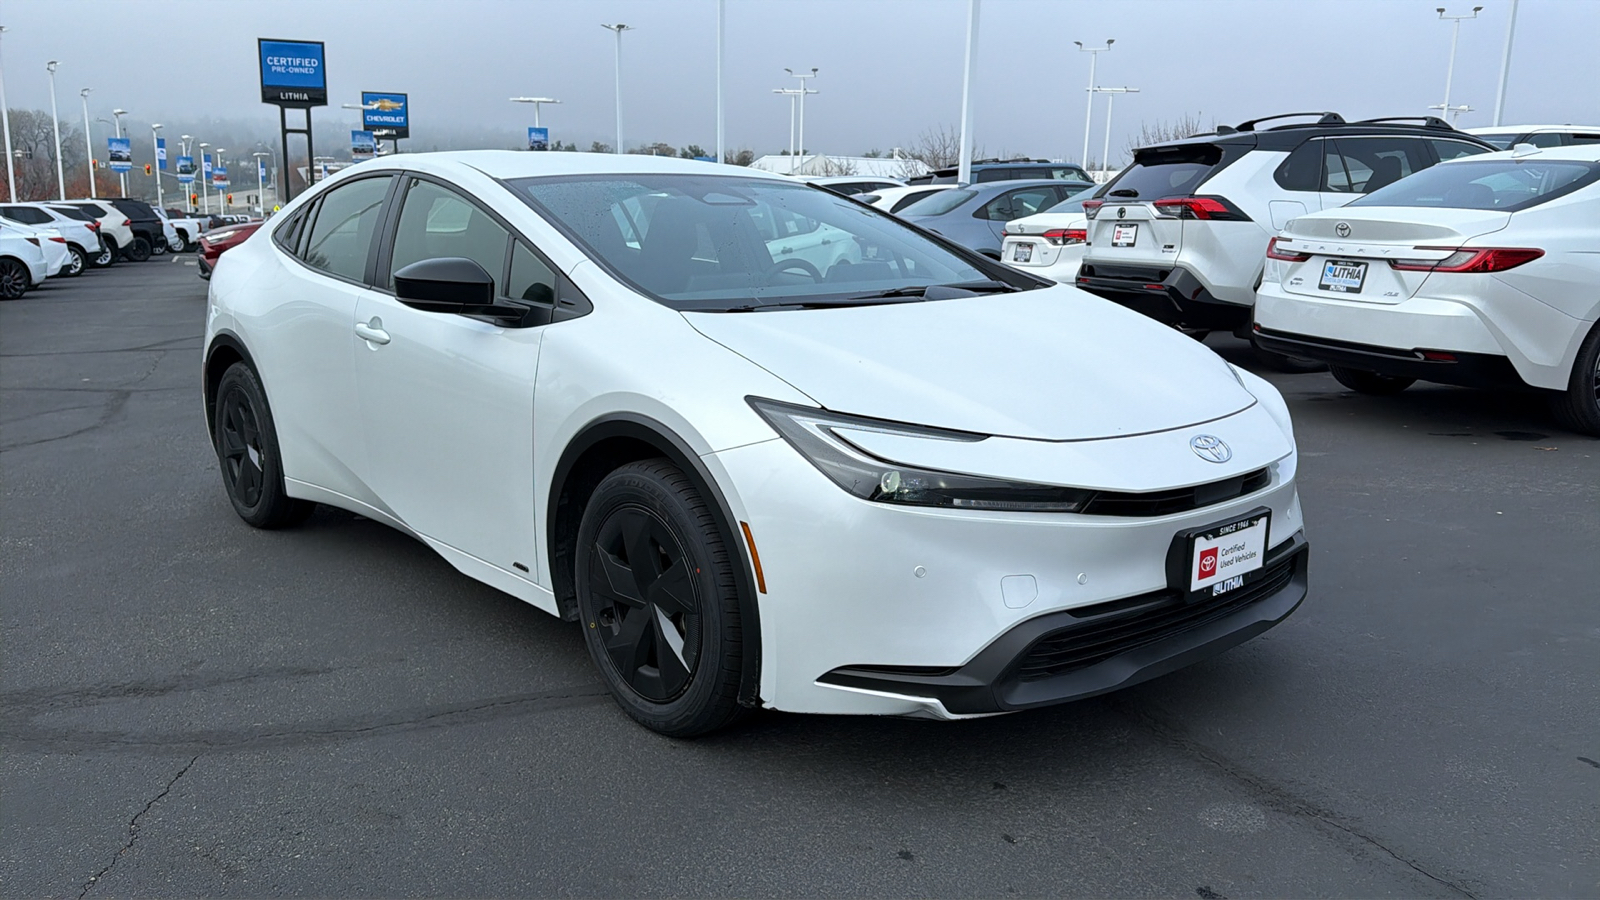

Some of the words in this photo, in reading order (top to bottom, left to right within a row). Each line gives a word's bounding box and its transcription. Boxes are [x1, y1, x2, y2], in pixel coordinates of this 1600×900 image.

[266, 56, 318, 67] CERTIFIED
[271, 66, 315, 75] PRE-OWNED
[280, 92, 309, 101] LITHIA
[366, 115, 405, 123] CHEVROLET
[375, 128, 397, 136] LIHIA
[1333, 266, 1361, 281] LITHIA
[1220, 524, 1236, 535] SINCE
[1221, 542, 1246, 557] Certified
[1220, 555, 1235, 569] Used
[1235, 550, 1257, 564] Vehicles
[1219, 574, 1244, 593] LITHIA
